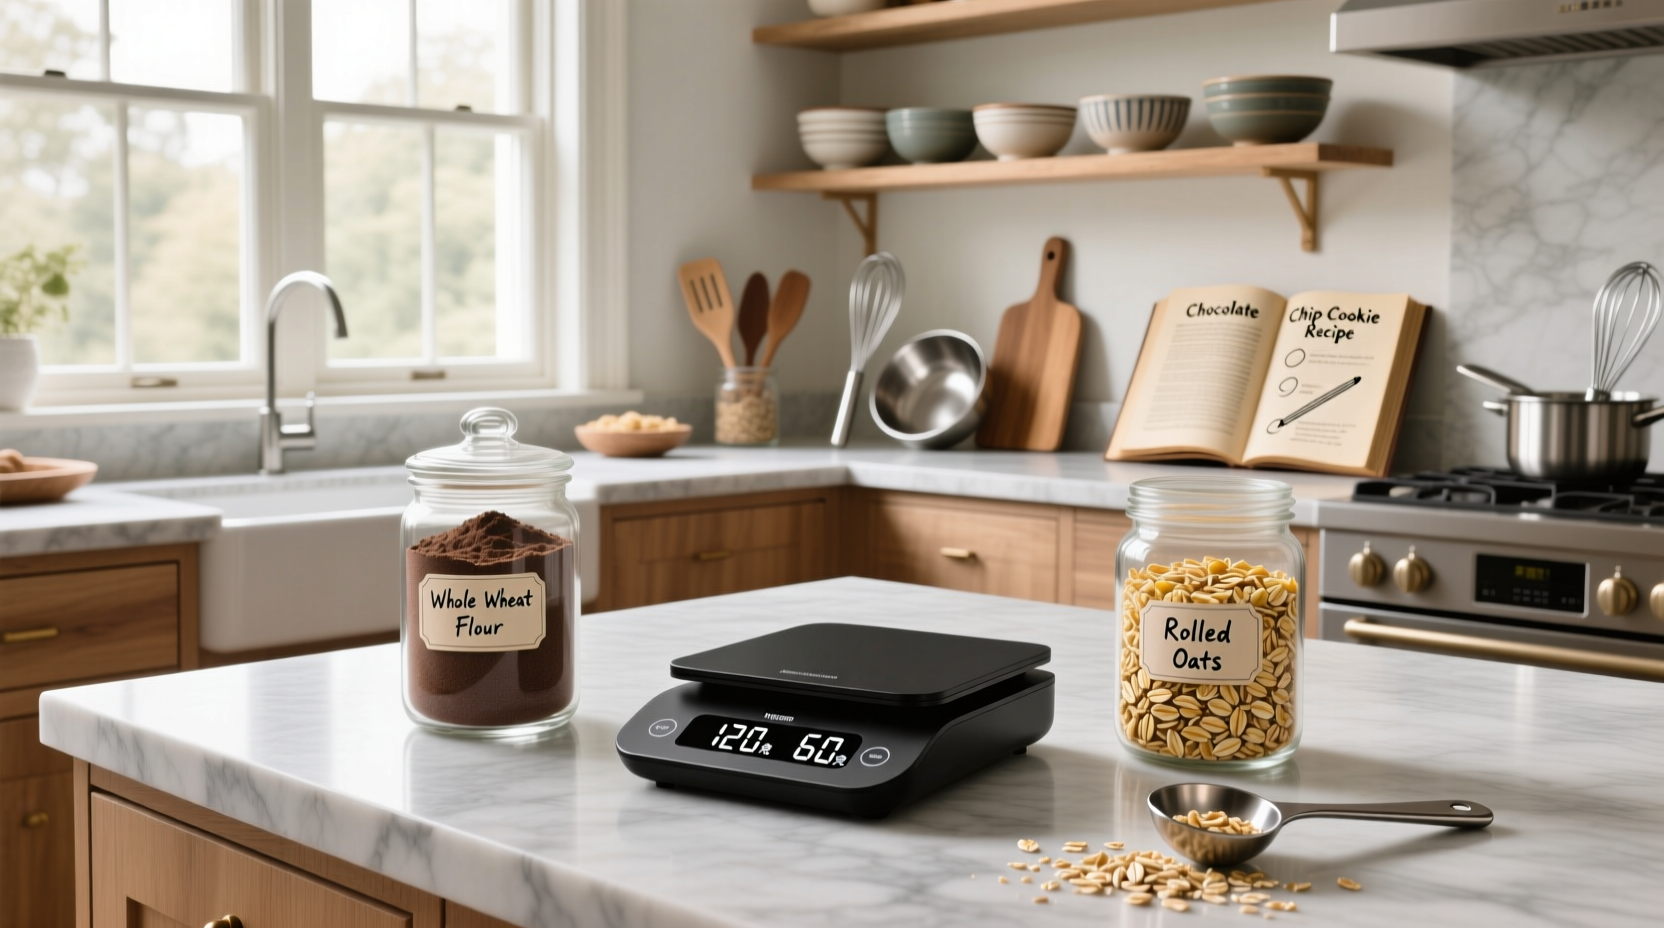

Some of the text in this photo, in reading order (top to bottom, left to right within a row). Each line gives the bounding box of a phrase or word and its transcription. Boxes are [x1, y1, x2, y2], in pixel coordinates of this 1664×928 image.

[1186, 300, 1260, 319] Chocolate
[1289, 306, 1380, 325] Chip Cookie
[1304, 324, 1355, 344] Recipe
[430, 587, 534, 609] Whole Wheat
[455, 615, 504, 637] Flour
[1164, 617, 1232, 643] Rolled
[1173, 647, 1222, 671] Oats
